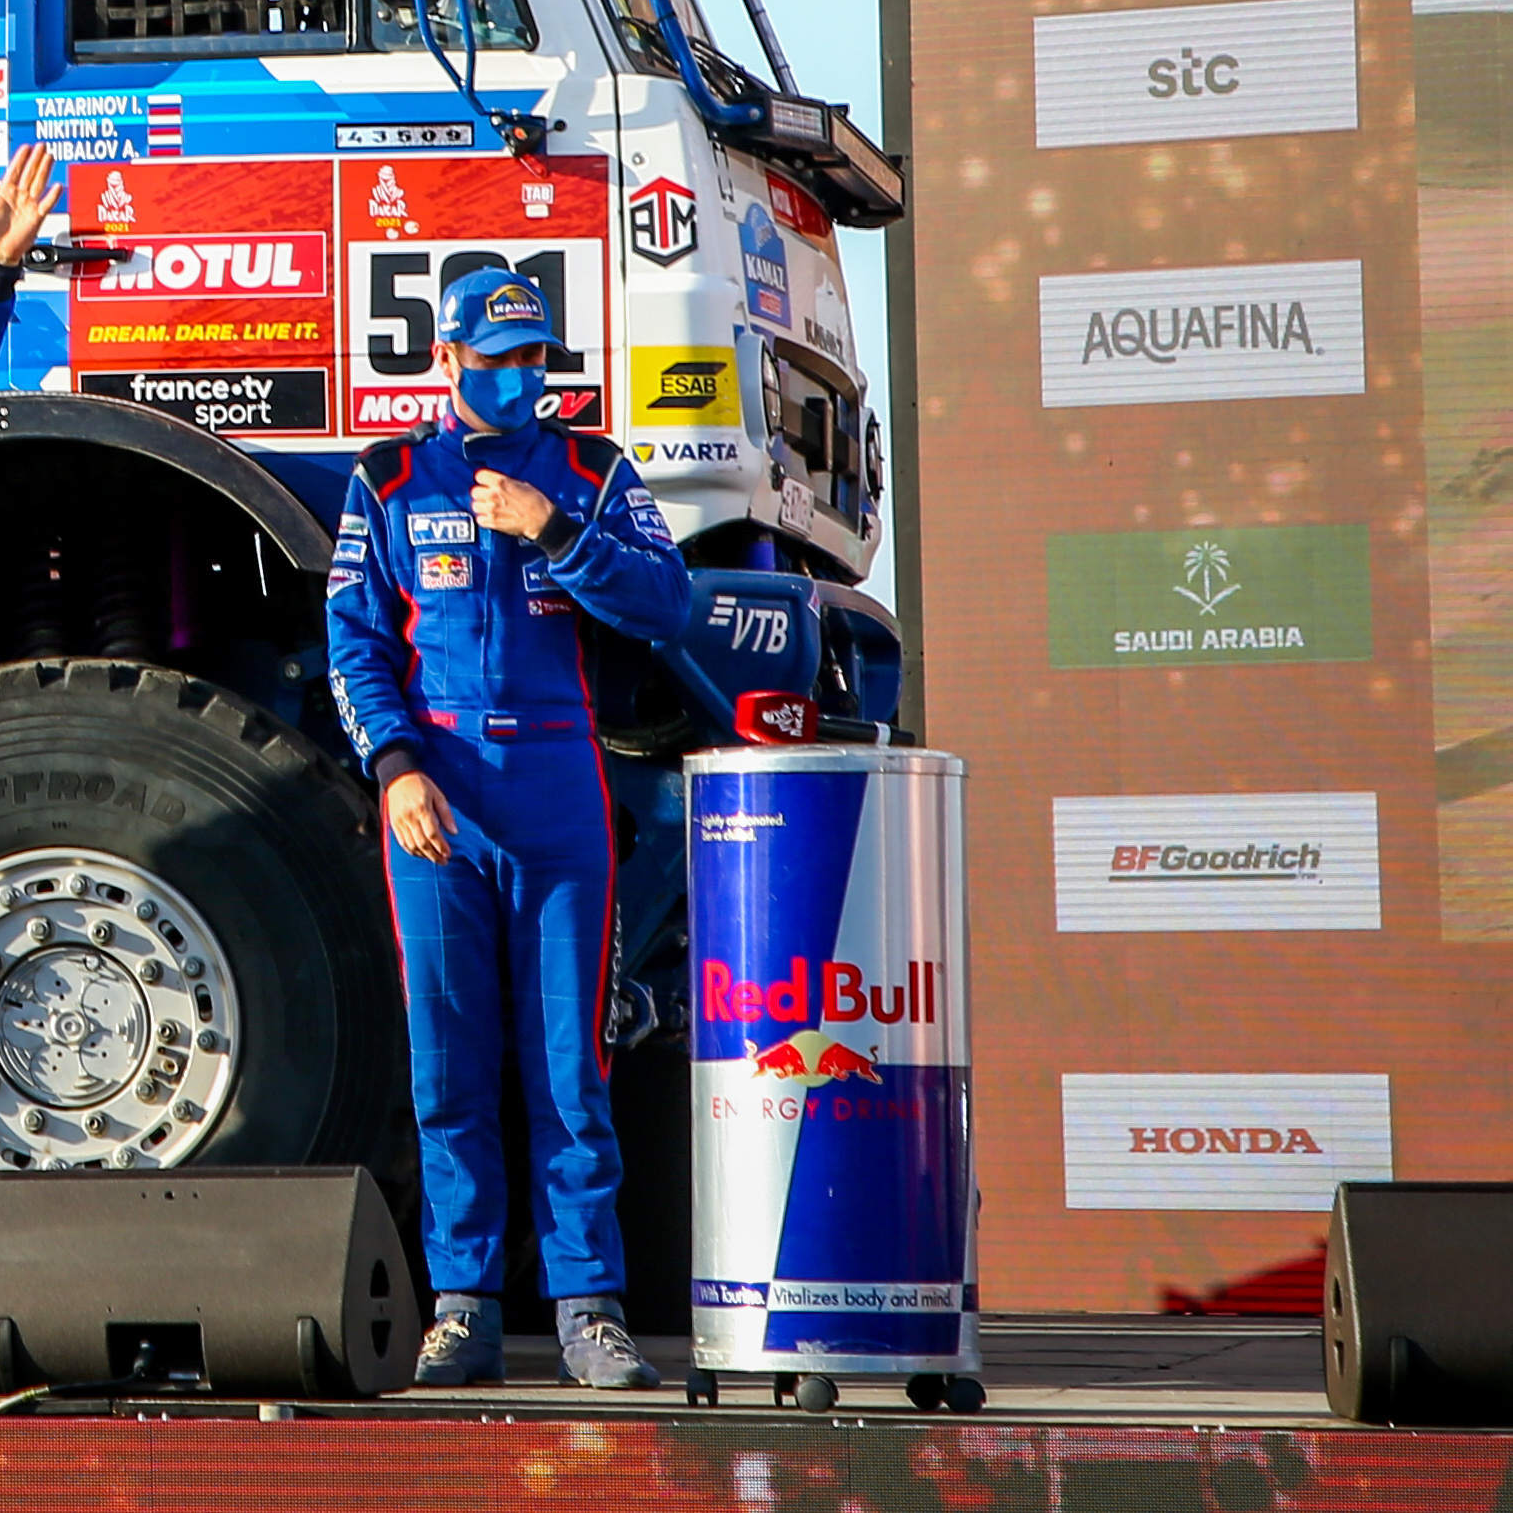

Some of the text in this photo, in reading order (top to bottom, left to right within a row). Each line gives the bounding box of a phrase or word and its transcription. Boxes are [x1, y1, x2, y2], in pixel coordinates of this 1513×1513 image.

[1147, 47, 1240, 98] stc
[35, 96, 127, 117] TATARINOV
[35, 118, 119, 140] NIKITIN D.
[45, 138, 140, 161] HIBALOV A.
[97, 204, 136, 223] DAKAR
[104, 223, 130, 232] 2021
[98, 242, 303, 291] MOTUL
[367, 250, 585, 376] 51
[88, 321, 319, 343] DREAM. DARE. LIVE IT.
[660, 373, 718, 395] ESAB
[194, 399, 273, 432] sport
[661, 441, 739, 462] VARTA
[430, 519, 470, 540] VTB
[730, 606, 789, 654] VTB
[1114, 627, 1304, 652] SAUDI ARABIA
[1111, 842, 1321, 871] BFGoodrich
[702, 956, 935, 1024] Red Bull
[833, 1097, 926, 1123] DRINK
[1128, 1127, 1323, 1155] HONDA
[773, 1286, 839, 1307] Vitalizes
[844, 1286, 886, 1311] body
[889, 1287, 919, 1307] and
[920, 1288, 955, 1308] mind.
